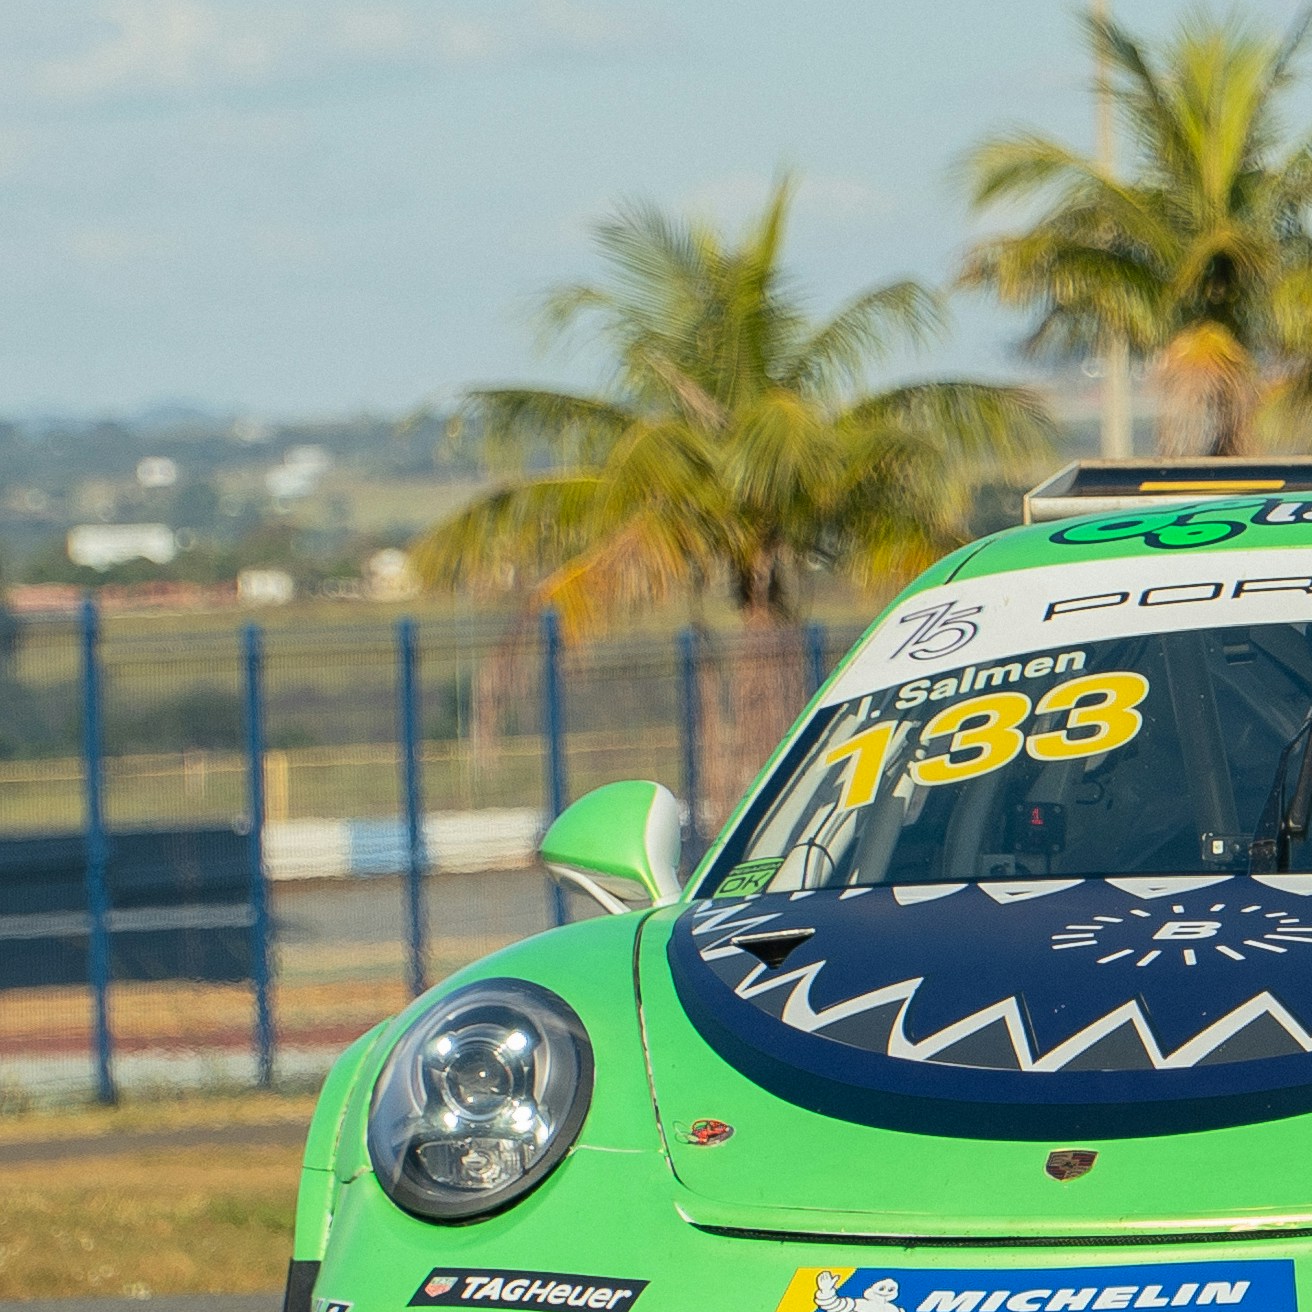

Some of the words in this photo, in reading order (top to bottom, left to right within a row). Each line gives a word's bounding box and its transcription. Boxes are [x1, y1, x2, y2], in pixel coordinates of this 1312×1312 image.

[895, 650, 1086, 710] Salmen
[825, 671, 1150, 811] 133
[916, 1281, 1251, 1312] MICHELIN
